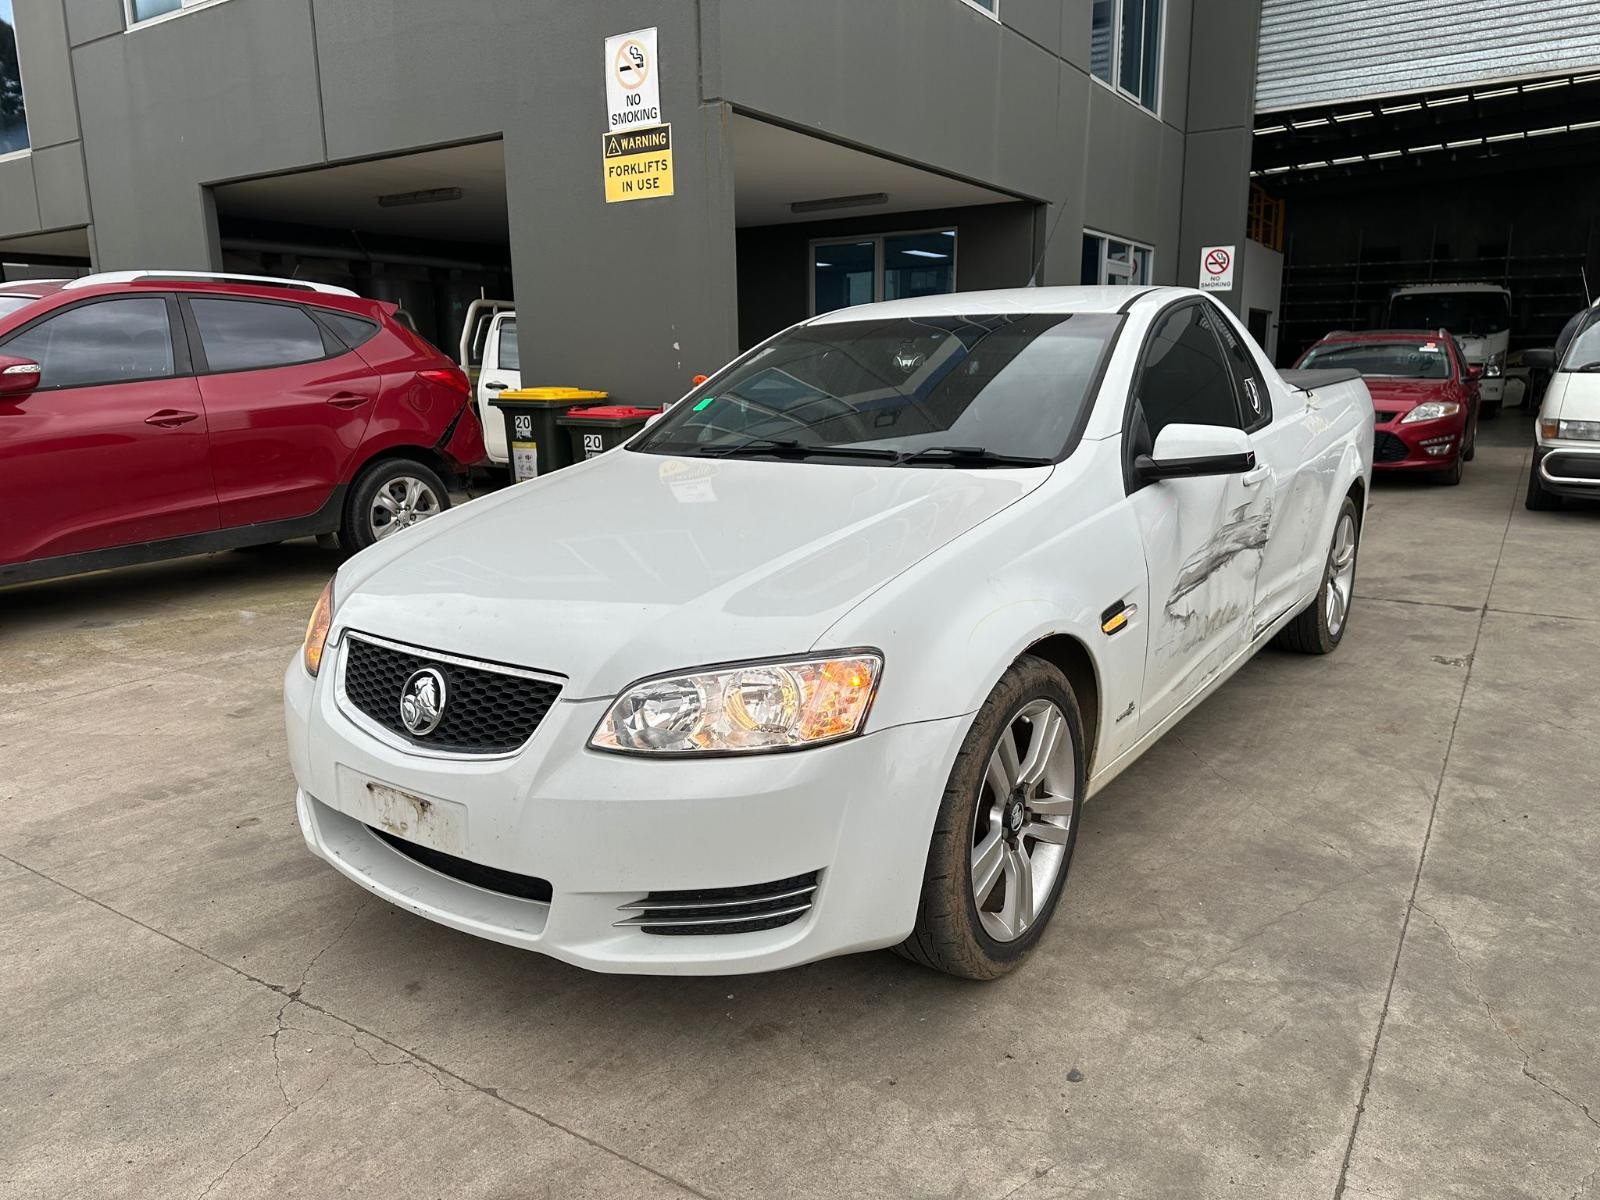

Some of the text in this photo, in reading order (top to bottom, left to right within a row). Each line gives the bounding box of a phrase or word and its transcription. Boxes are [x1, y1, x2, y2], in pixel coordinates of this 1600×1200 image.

[626, 93, 641, 107] NO
[611, 107, 658, 126] SMOKING
[620, 132, 667, 150] WARNING
[608, 159, 668, 178] FORKLIFTS
[622, 177, 660, 193] IN USE
[516, 416, 530, 429] 20
[585, 435, 601, 448] 20
